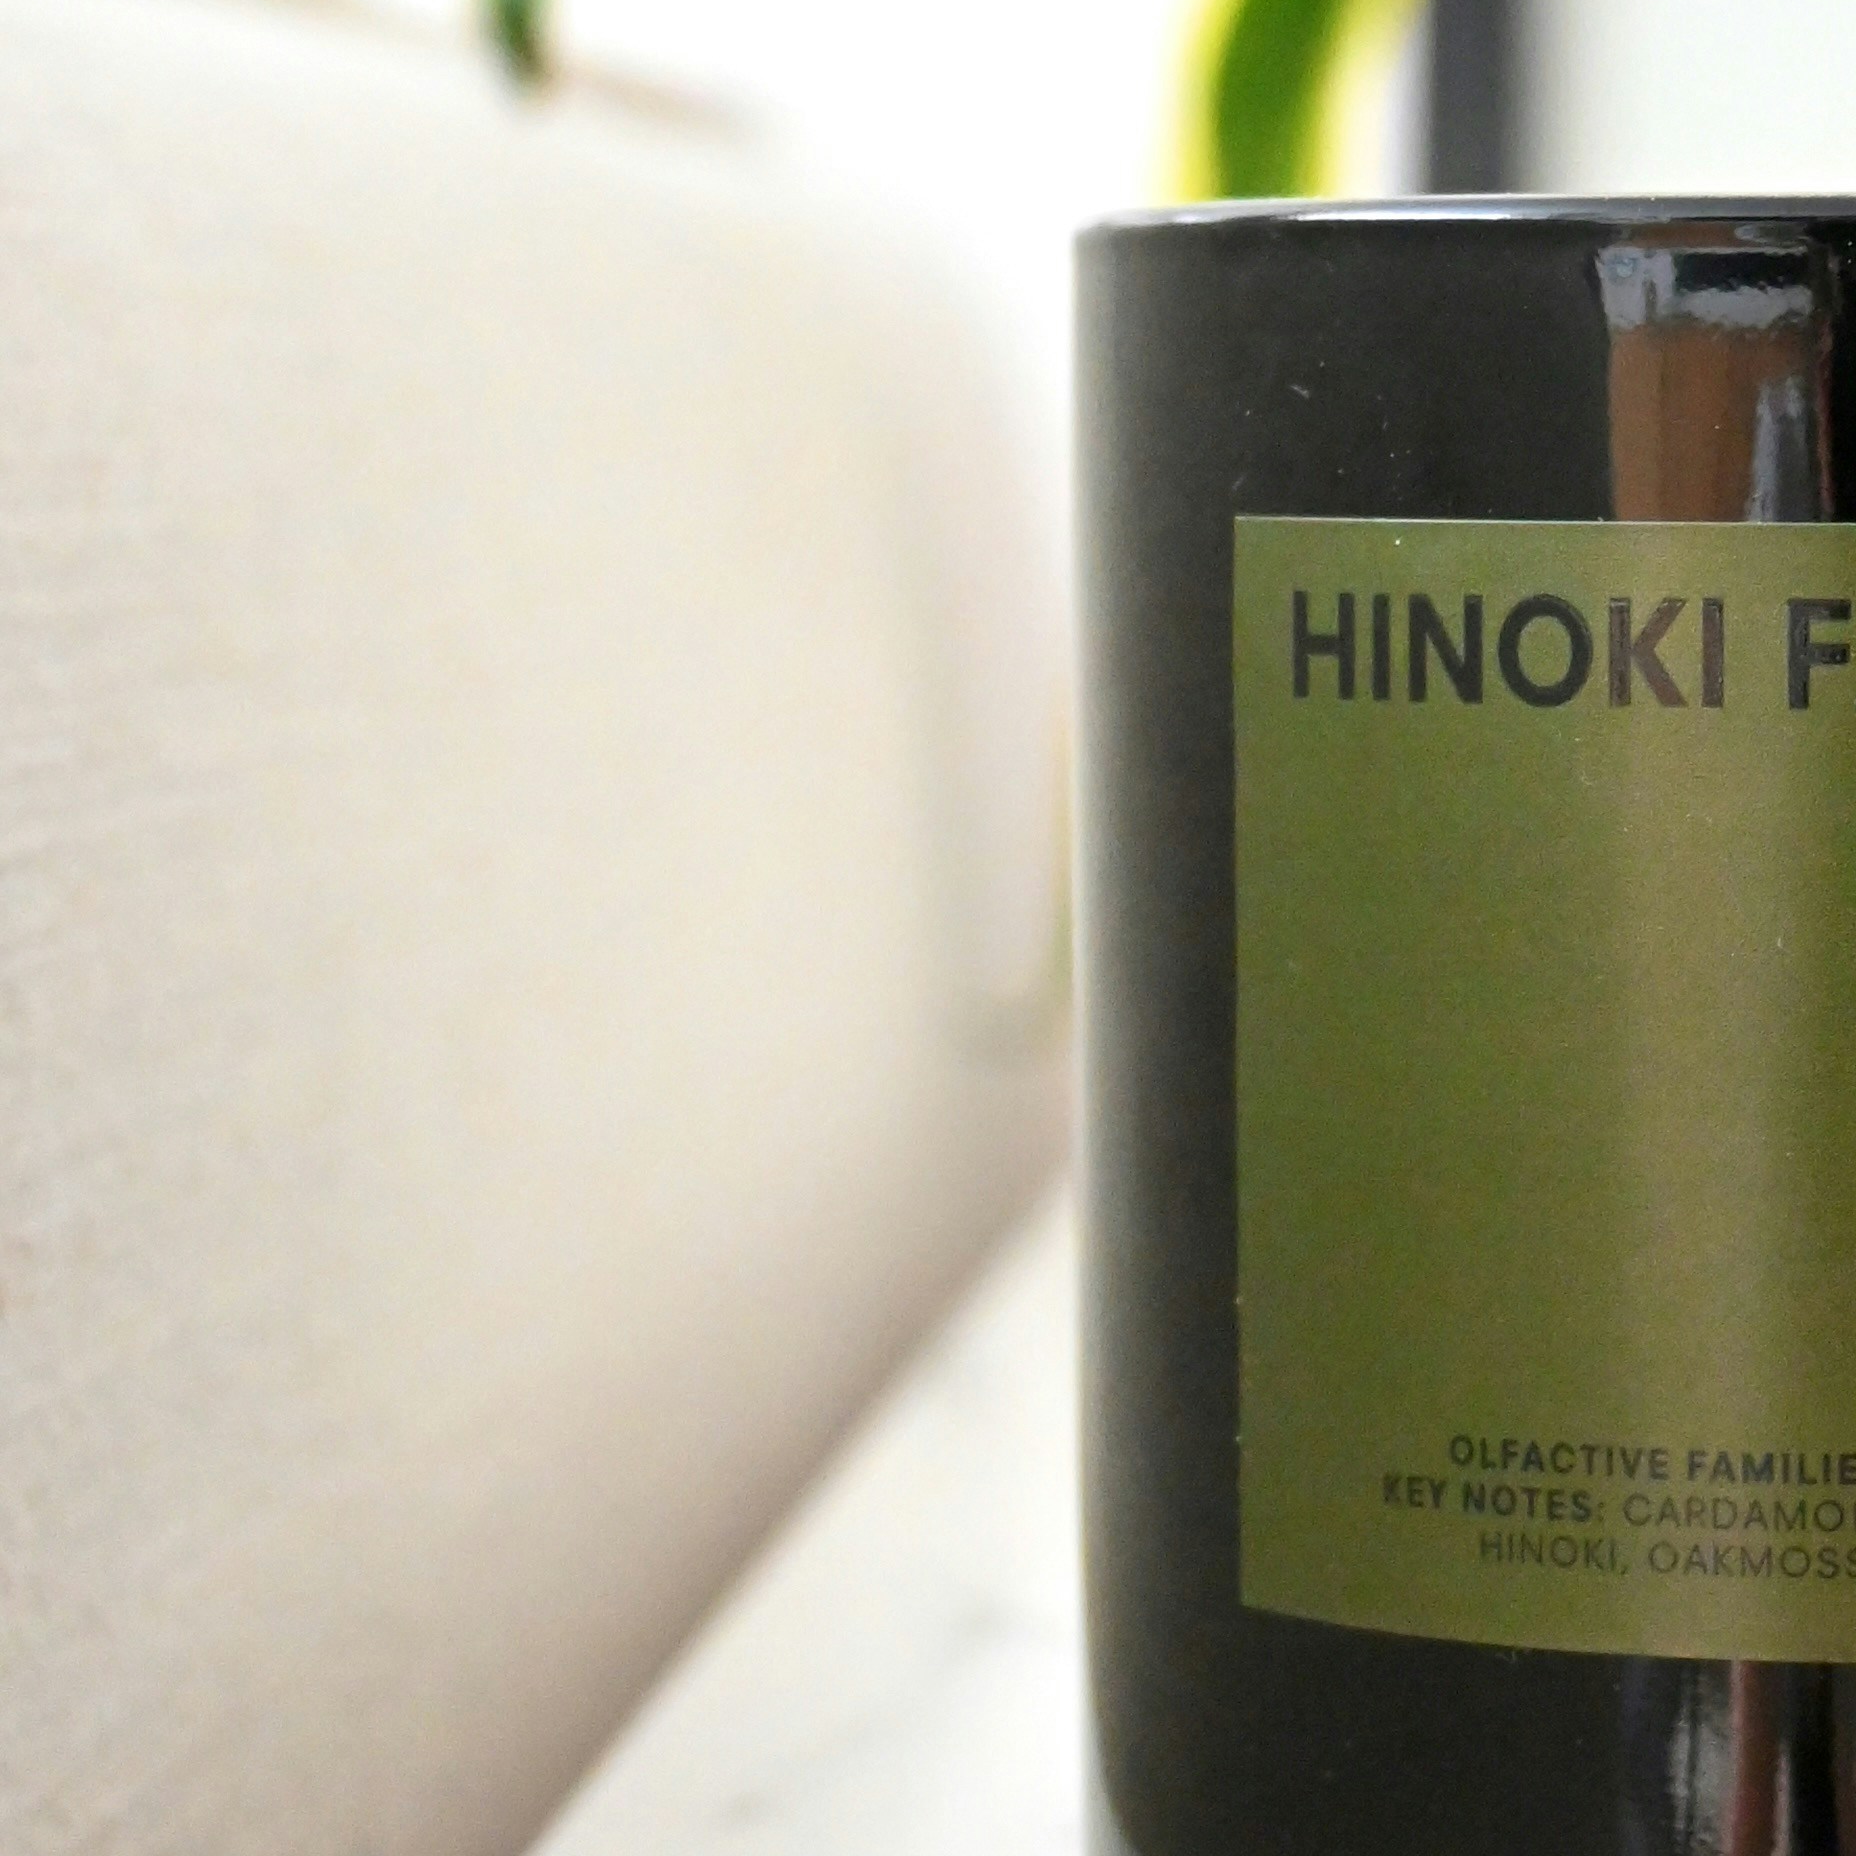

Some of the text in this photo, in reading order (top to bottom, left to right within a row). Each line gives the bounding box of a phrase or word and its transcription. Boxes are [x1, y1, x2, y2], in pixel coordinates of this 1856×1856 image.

[1292, 590, 1725, 710] HINOKI
[1449, 1435, 1669, 1480] OLFACTIVE
[1384, 1474, 1446, 1511] KEY
[1463, 1484, 1606, 1522] NOTES:
[1479, 1532, 1629, 1575] HINOKI,
